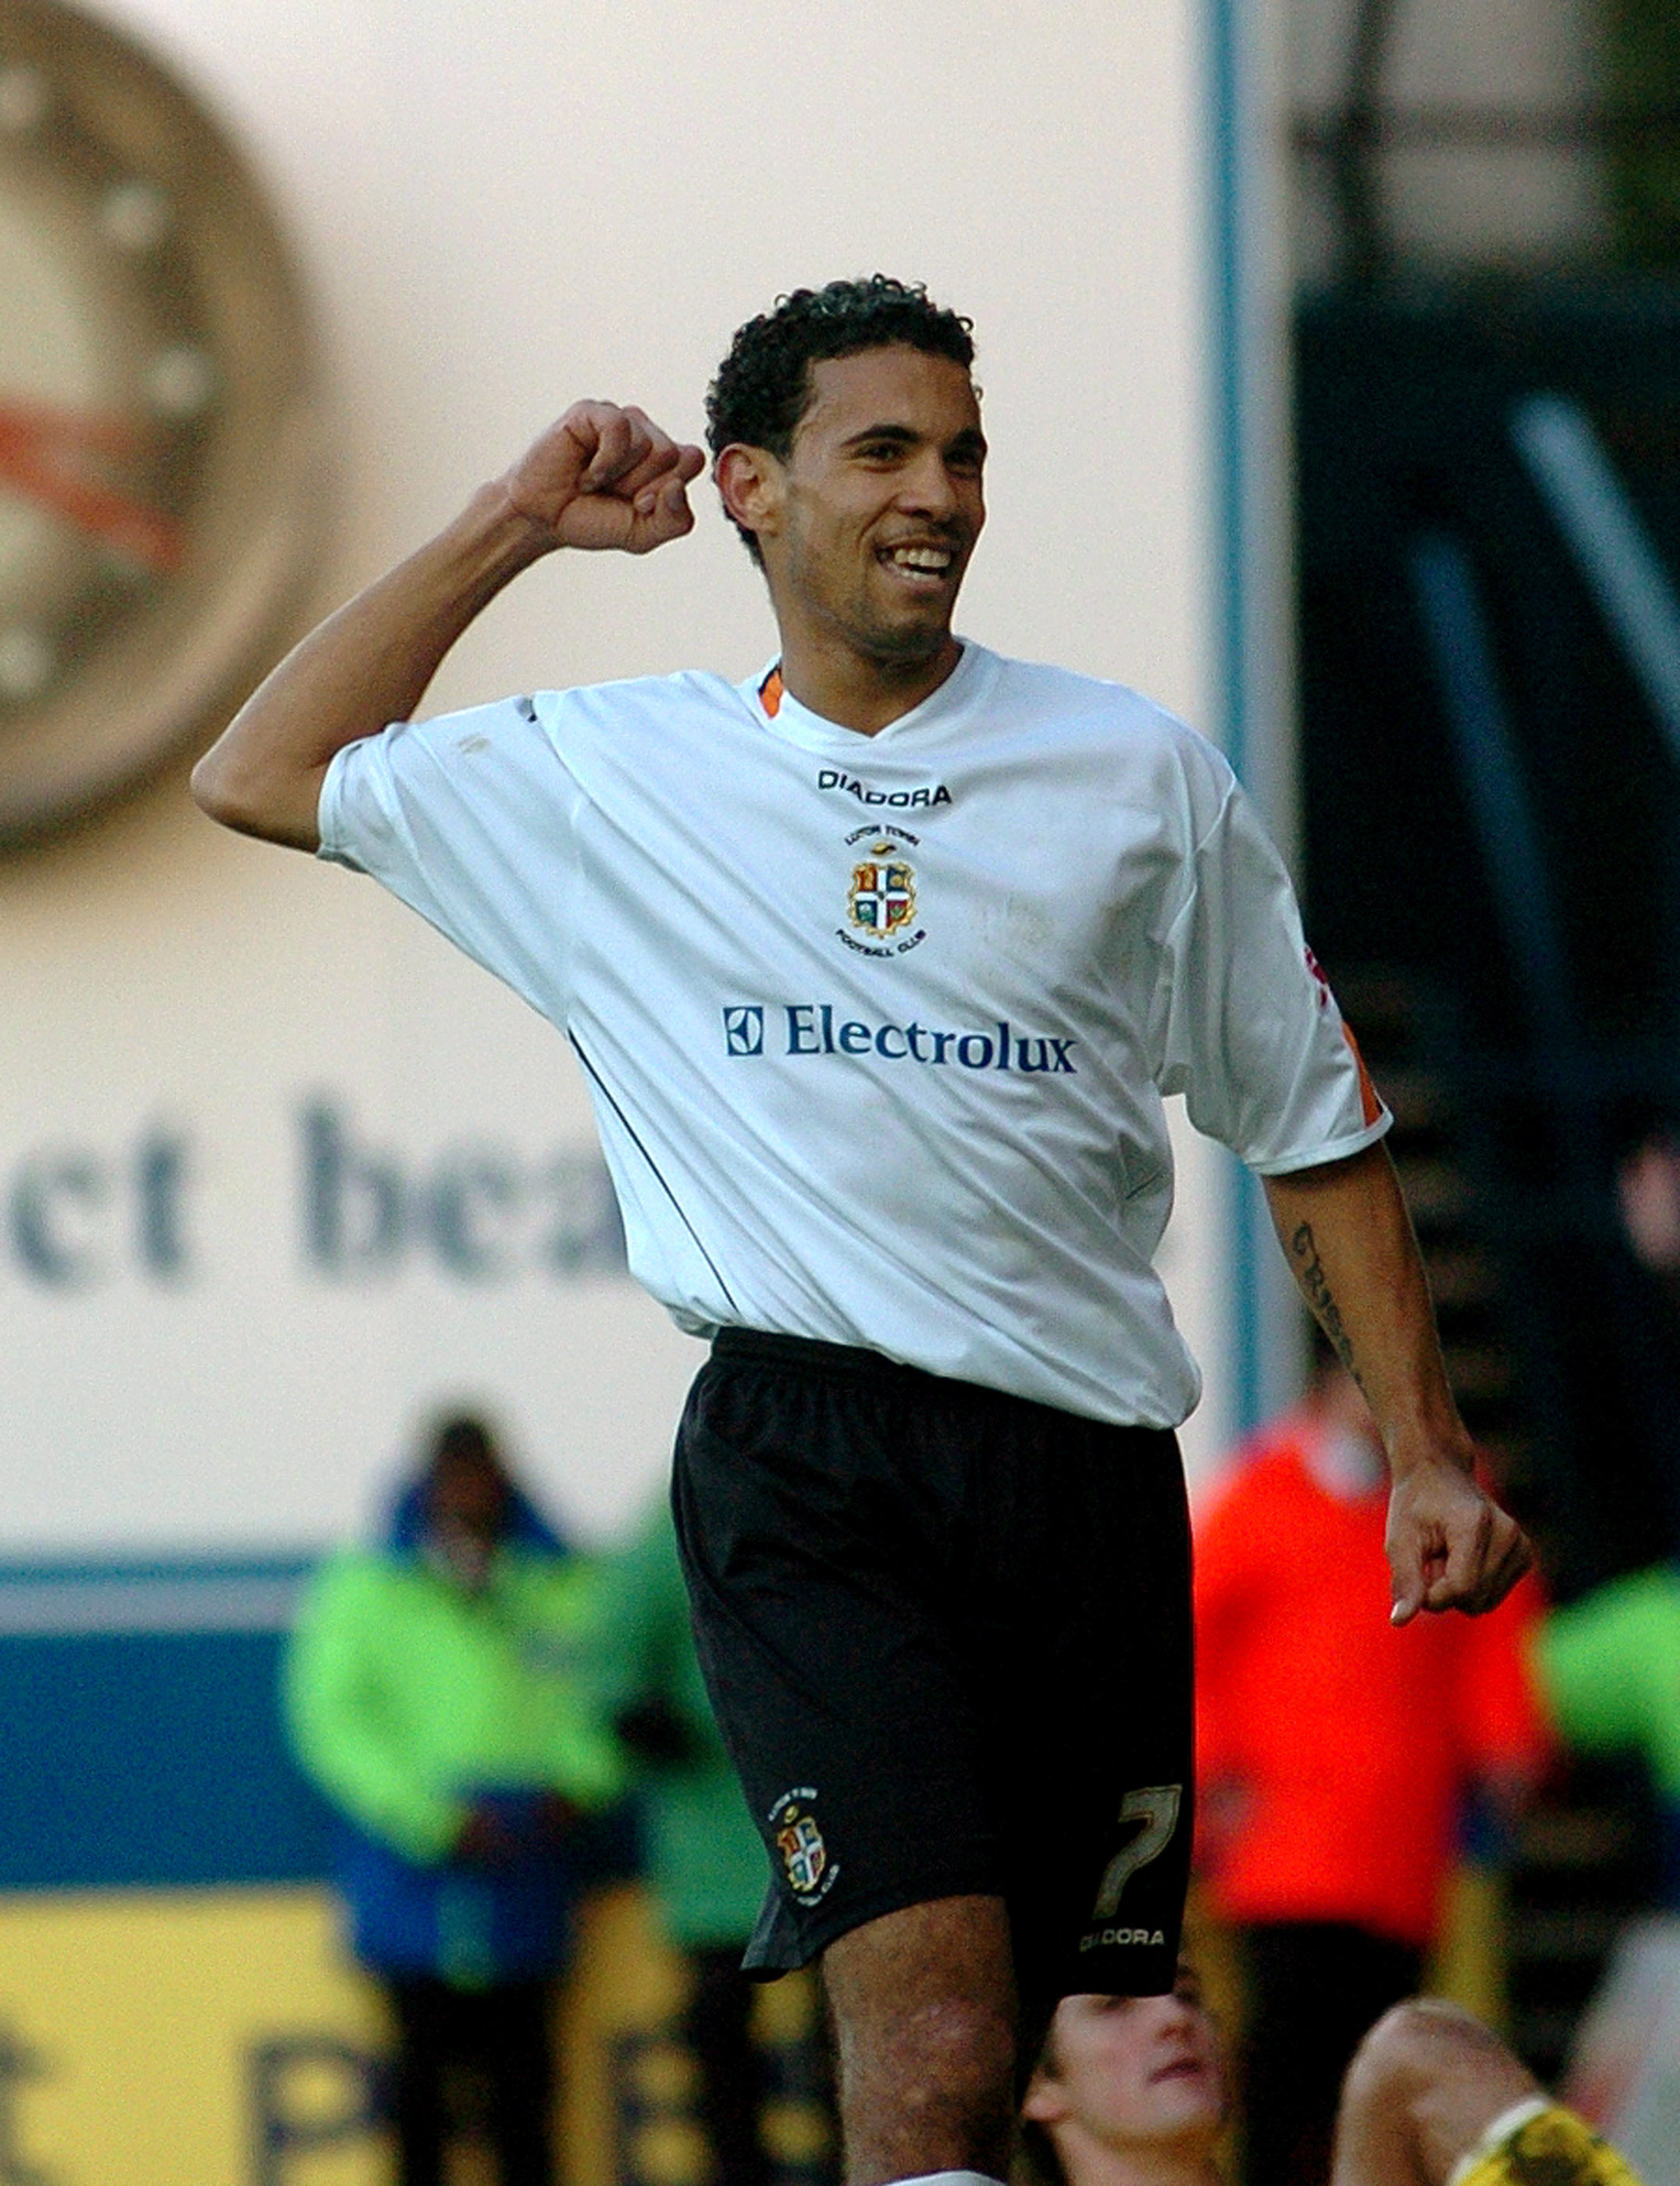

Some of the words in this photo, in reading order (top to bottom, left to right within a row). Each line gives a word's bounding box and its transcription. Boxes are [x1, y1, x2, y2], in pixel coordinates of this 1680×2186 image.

[818, 770, 952, 807] DIADORA
[785, 1004, 1077, 1073] Electrolux
[1093, 1783, 1183, 1920] 7
